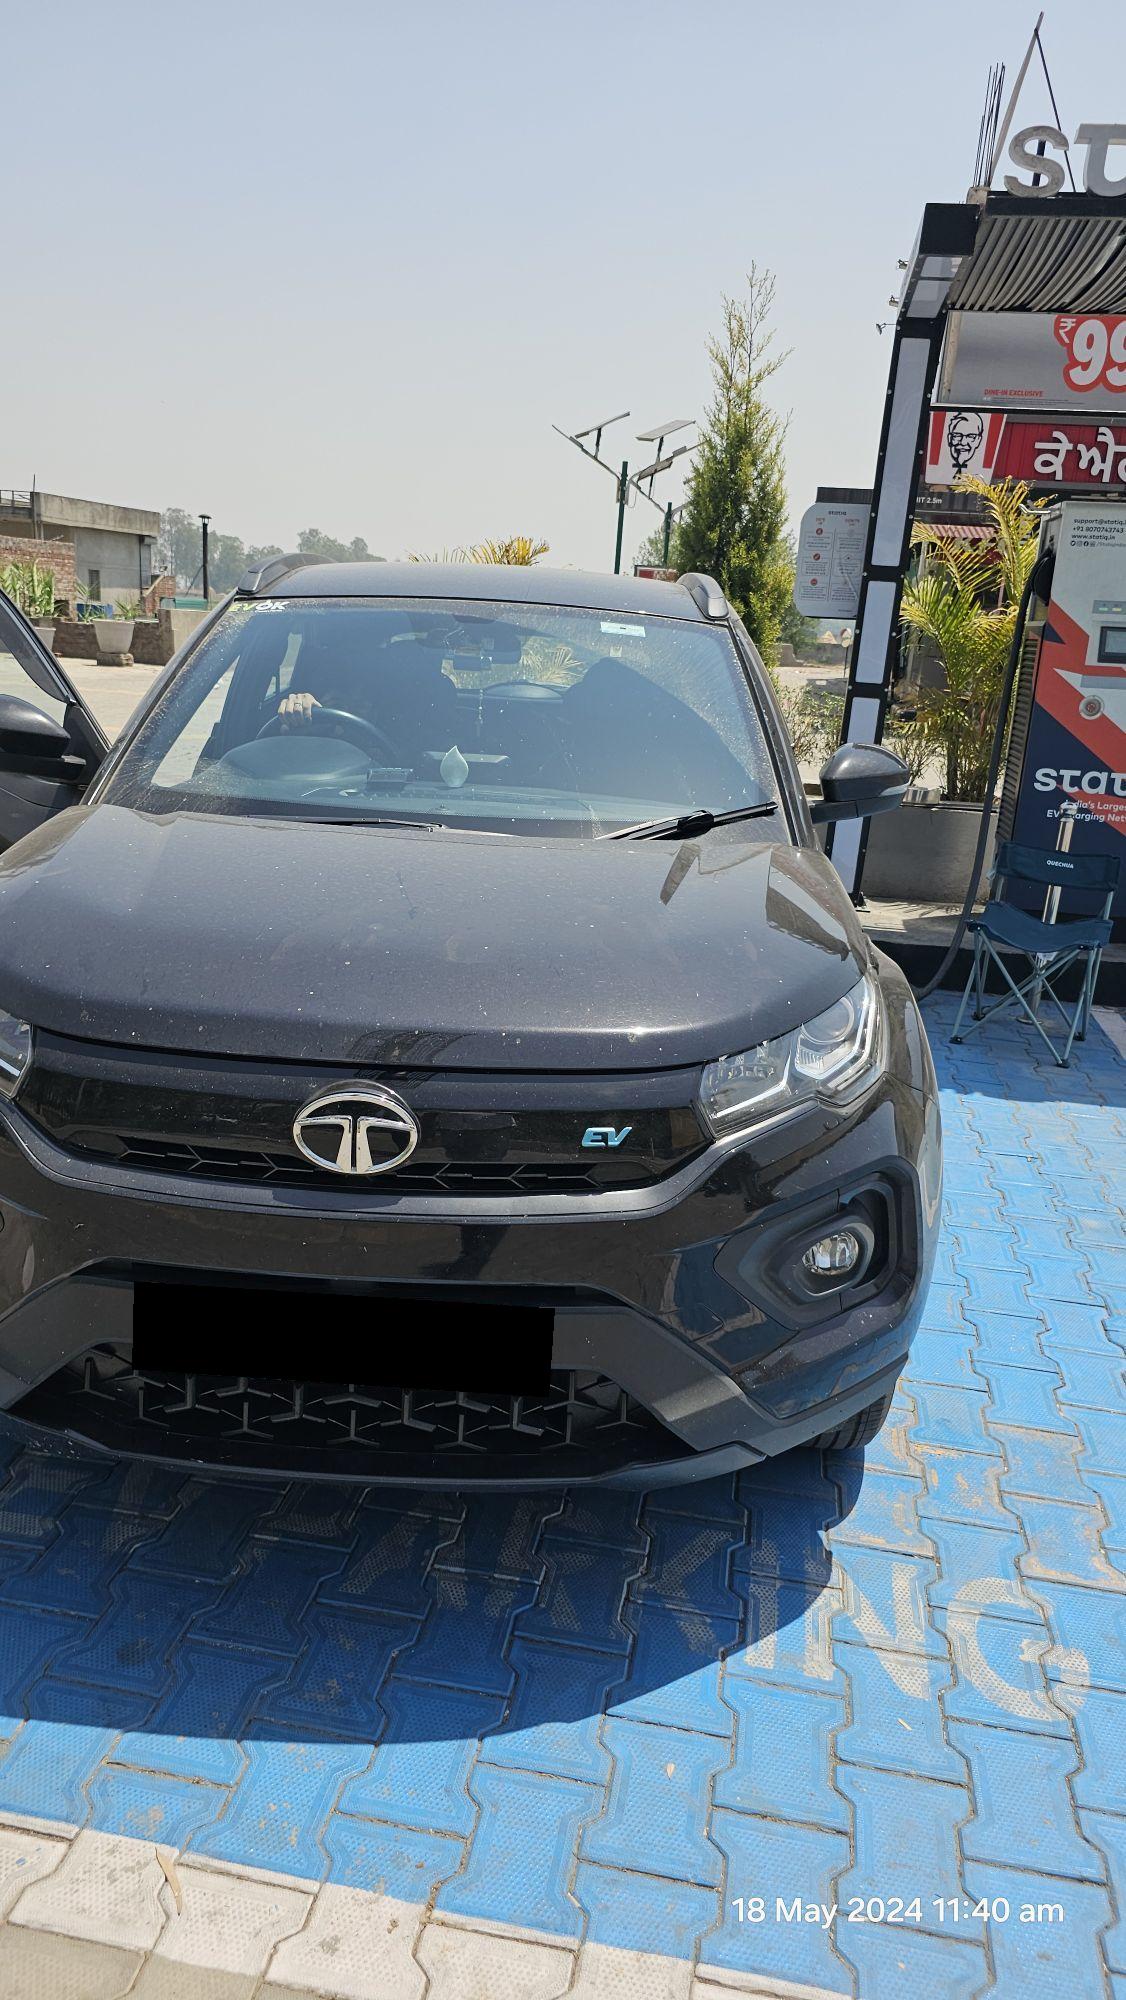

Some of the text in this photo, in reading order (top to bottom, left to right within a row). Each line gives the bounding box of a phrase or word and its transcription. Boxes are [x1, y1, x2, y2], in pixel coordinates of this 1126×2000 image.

[1008, 389, 1044, 398] EXCLUSIVE
[1097, 801, 1126, 813] Large
[1046, 809, 1060, 818] EV
[1046, 859, 1074, 869] QUECHUA
[581, 1126, 632, 1147] EV
